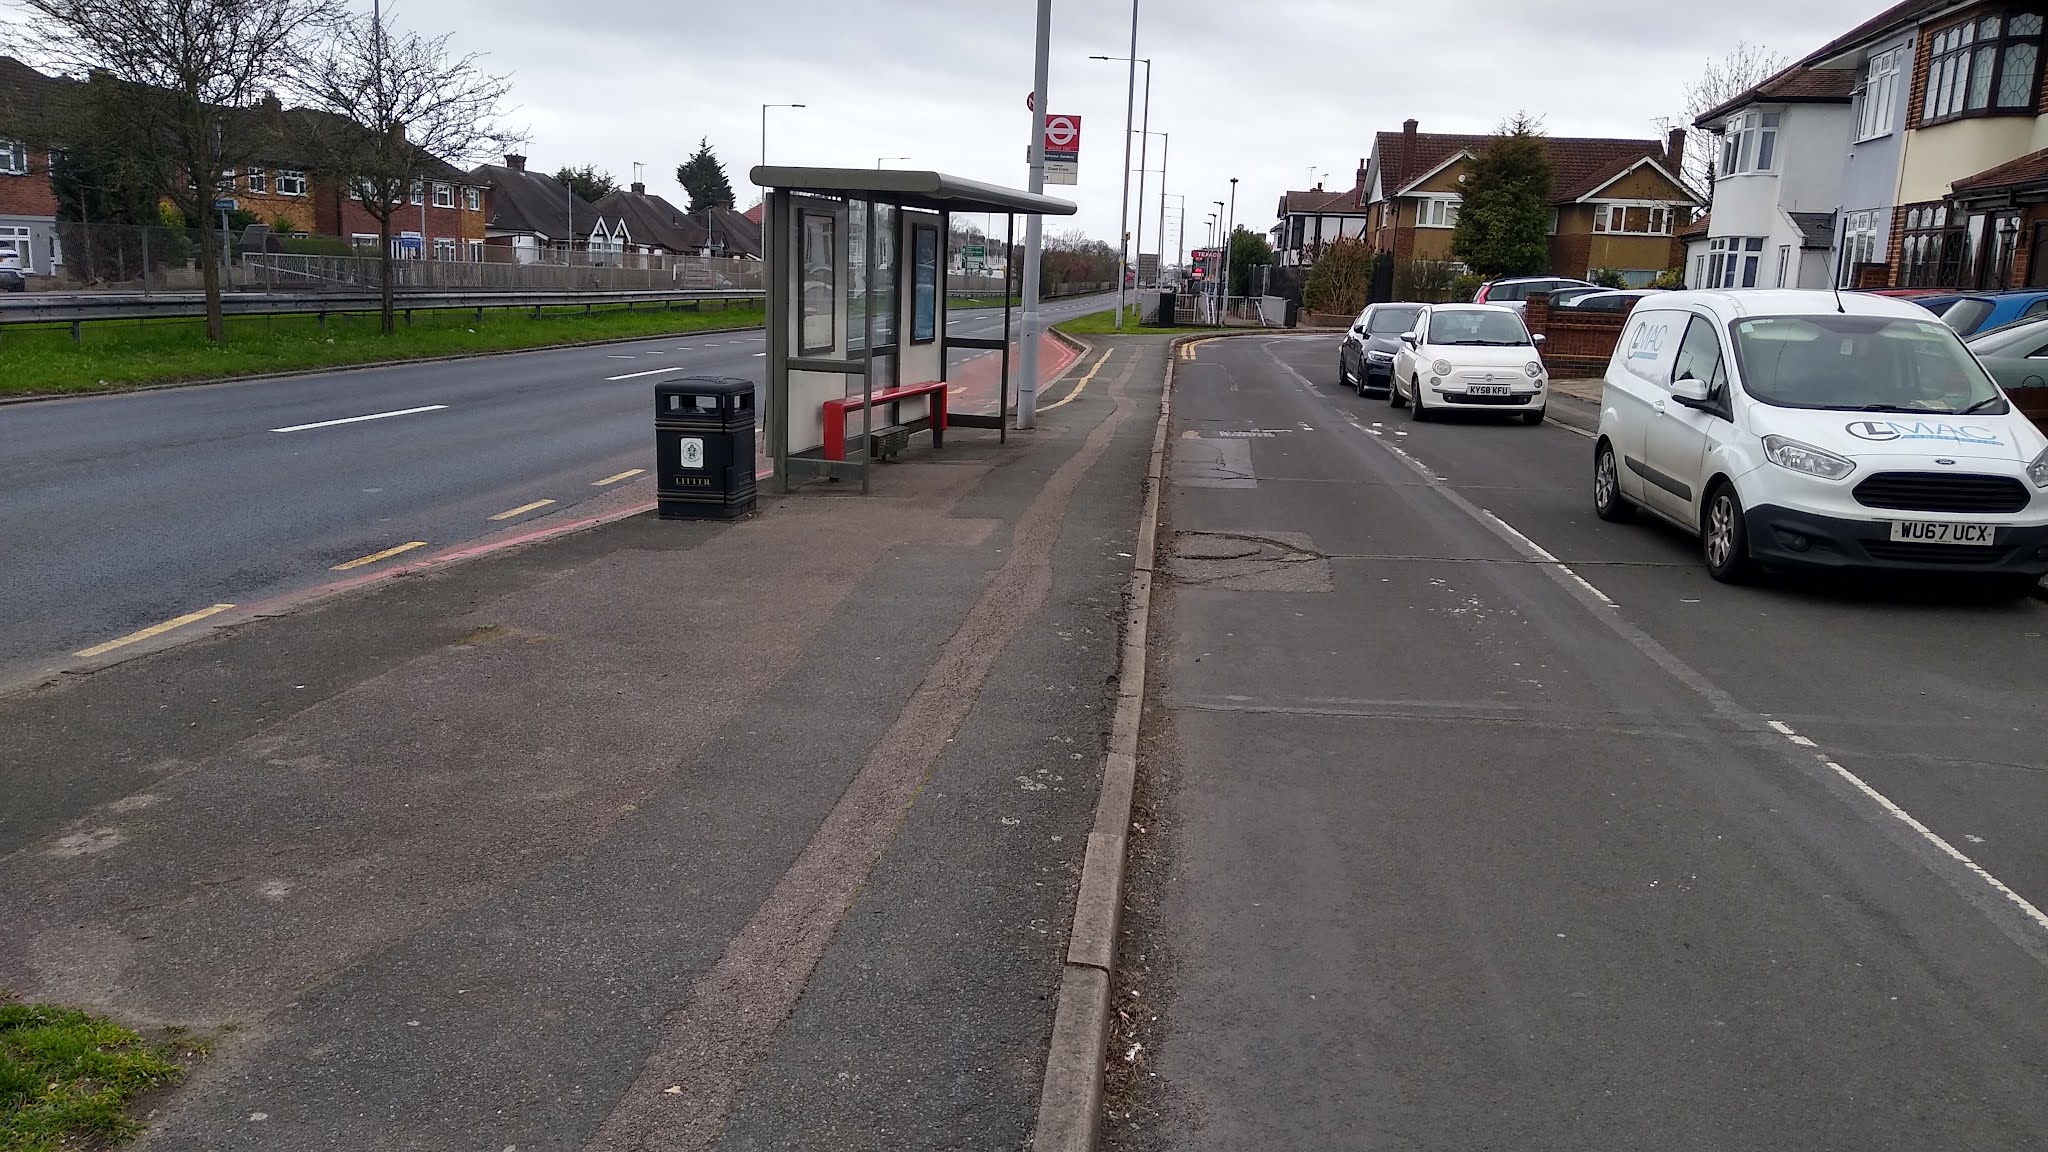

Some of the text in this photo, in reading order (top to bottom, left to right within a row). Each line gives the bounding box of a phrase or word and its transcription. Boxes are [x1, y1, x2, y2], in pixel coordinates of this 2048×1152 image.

[1469, 386, 1508, 395] KY58 KFU
[675, 477, 711, 486] LITTER
[1901, 522, 1989, 542] WU67 UCX
